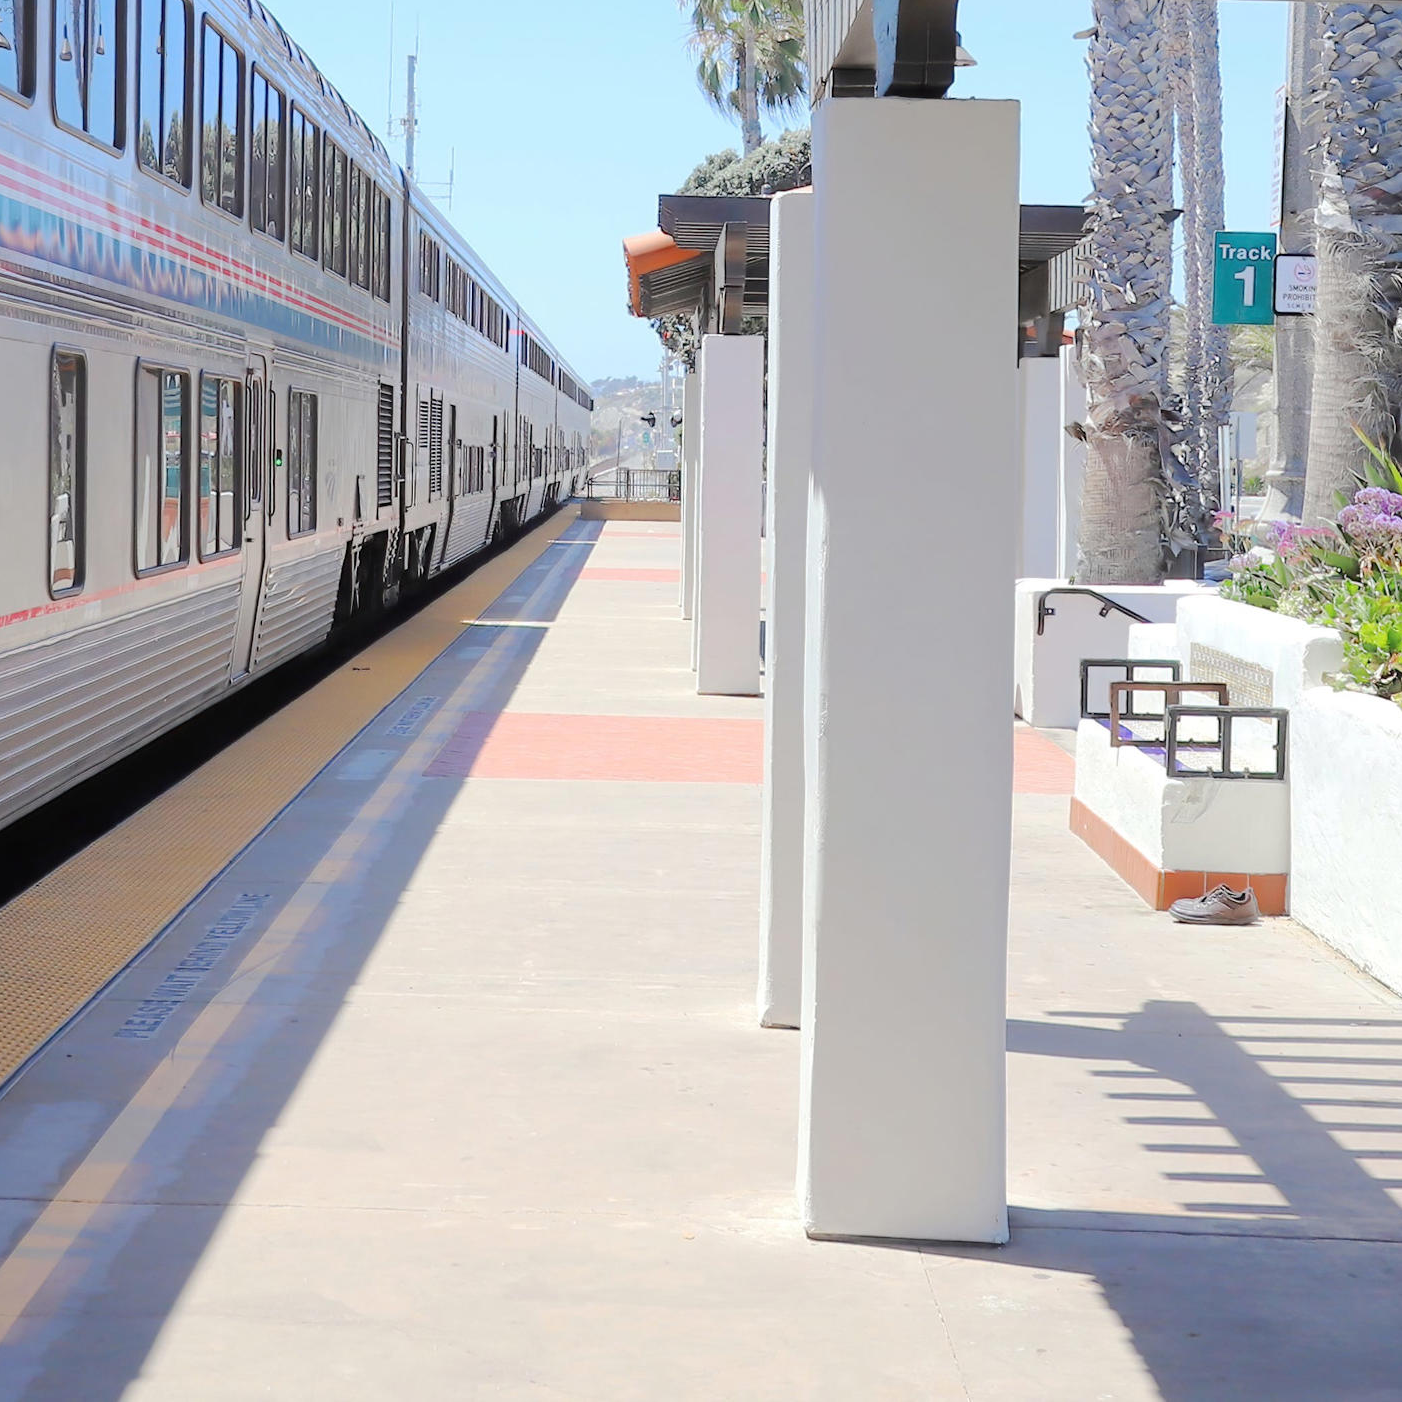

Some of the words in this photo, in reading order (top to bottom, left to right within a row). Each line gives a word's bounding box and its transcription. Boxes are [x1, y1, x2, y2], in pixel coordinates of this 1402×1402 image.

[1219, 243, 1272, 261] Track
[1234, 265, 1255, 307] 1
[1288, 284, 1317, 292] SMOKIN
[1282, 293, 1317, 301] PROHIBIT
